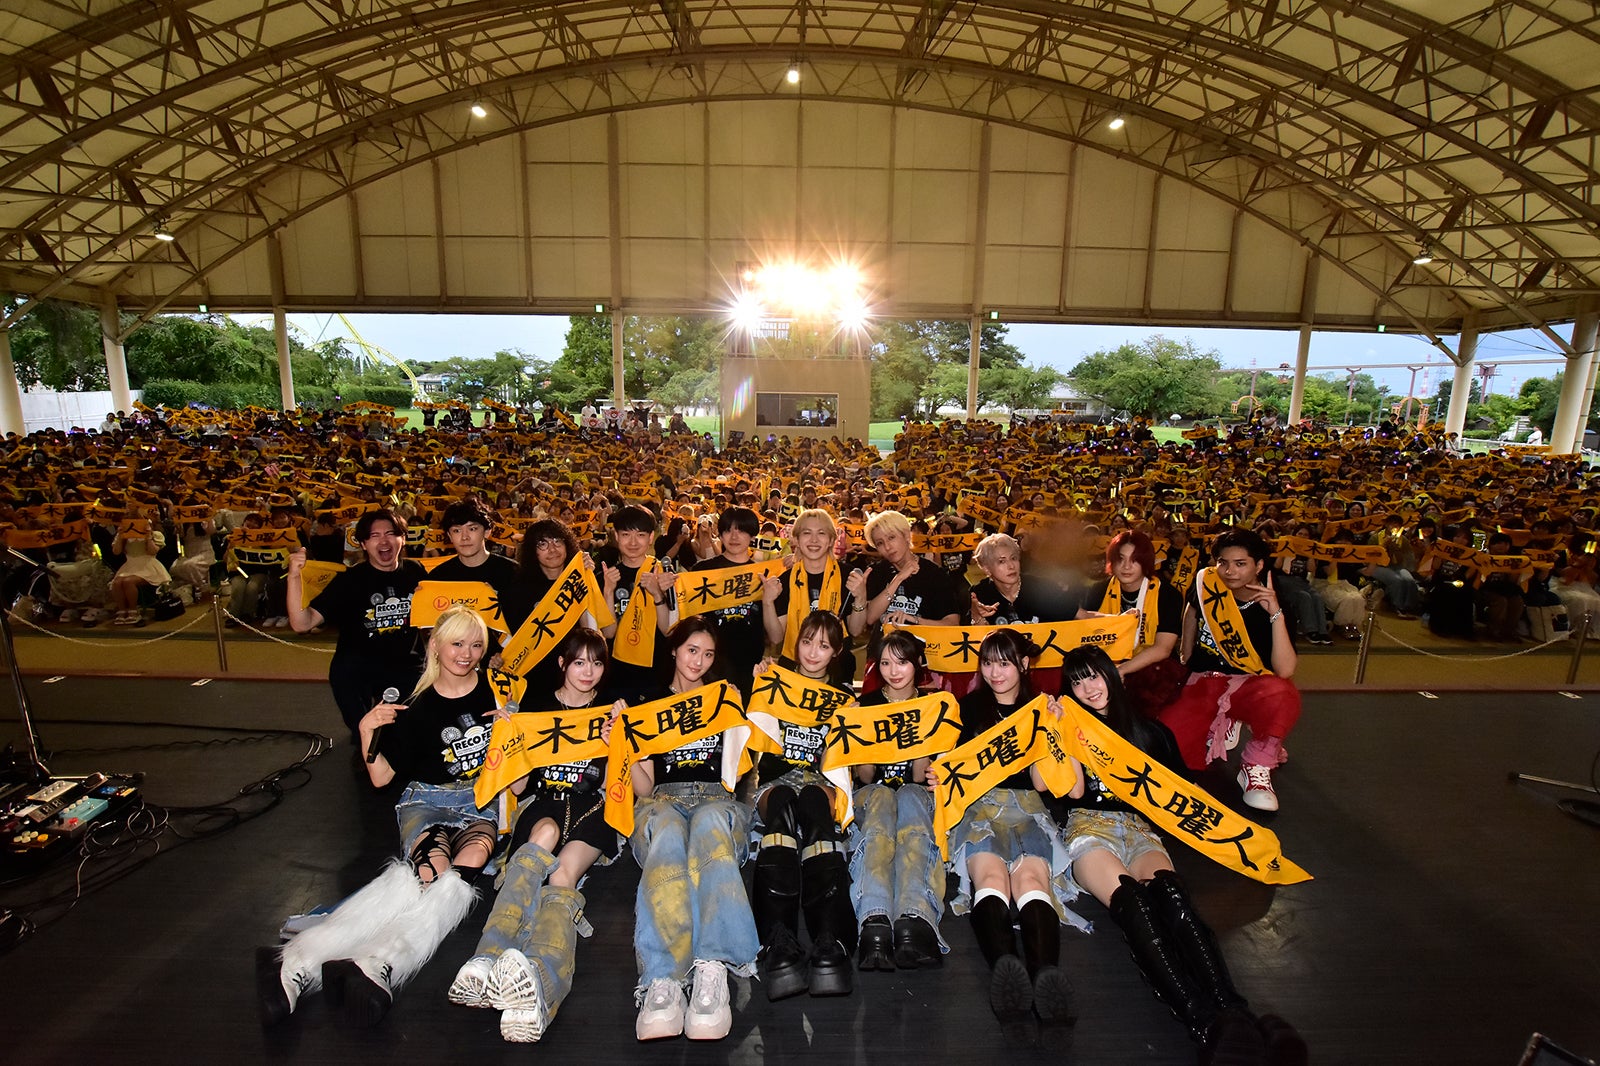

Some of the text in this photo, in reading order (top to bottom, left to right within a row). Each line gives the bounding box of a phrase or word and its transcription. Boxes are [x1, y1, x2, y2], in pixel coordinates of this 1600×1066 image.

[620, 486, 656, 498] 木曜人
[235, 530, 297, 543] 木曜人
[921, 536, 973, 550] 木曜人
[1308, 543, 1365, 560] 木曜人
[451, 597, 479, 605] レコメン!
[531, 568, 589, 650] 木曜
[508, 646, 530, 671] レコメン!
[943, 629, 1068, 663] 木人
[751, 670, 849, 722] 木曜
[621, 683, 748, 753] 木曜人
[828, 700, 964, 754] 木曜人
[941, 709, 1048, 808] 木曜人
[1109, 762, 1260, 872] 木曜人
